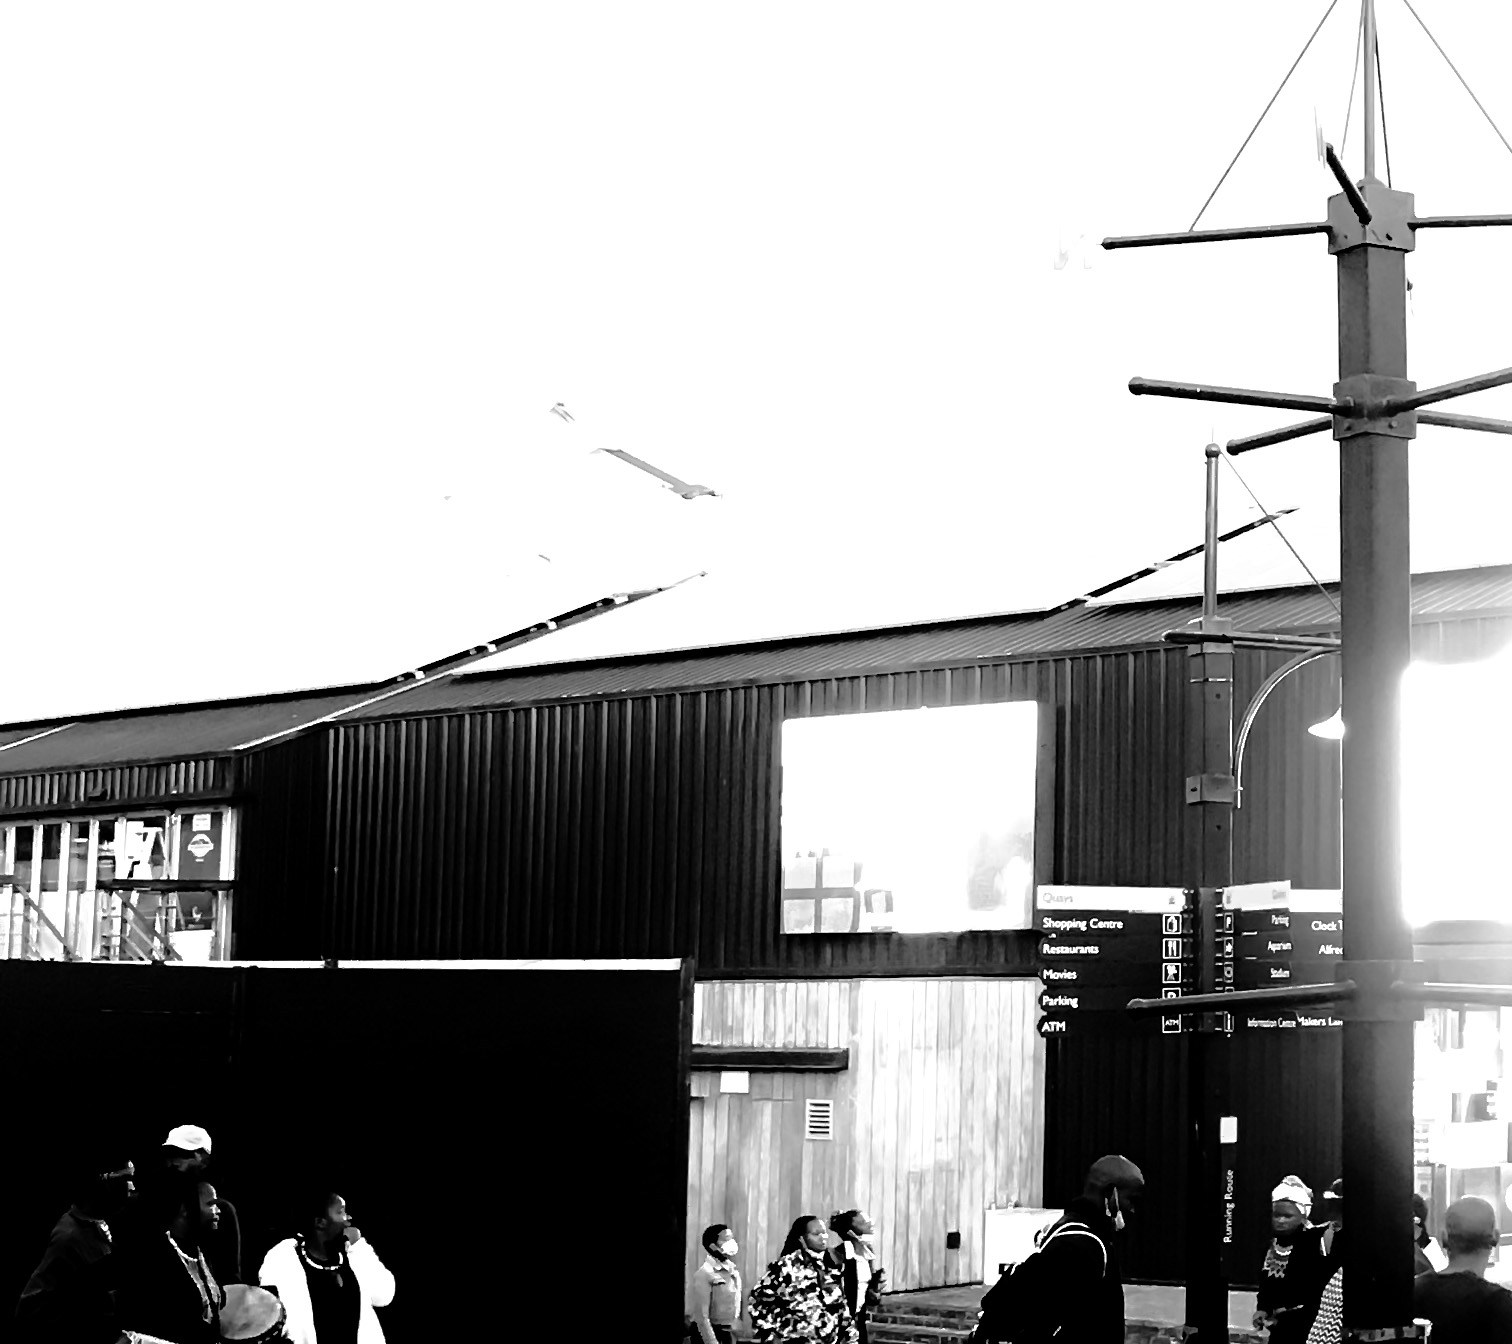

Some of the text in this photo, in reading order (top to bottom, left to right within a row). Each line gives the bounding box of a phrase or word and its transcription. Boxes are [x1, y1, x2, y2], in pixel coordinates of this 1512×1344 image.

[1042, 916, 1124, 931] Shopping Centre
[1311, 920, 1337, 931] Clock
[1042, 943, 1100, 955] Restaurants
[1042, 969, 1078, 980] Movies
[1042, 994, 1079, 1009] Parking
[1041, 1020, 1066, 1032] ATM
[1223, 1169, 1235, 1243] Running Route
